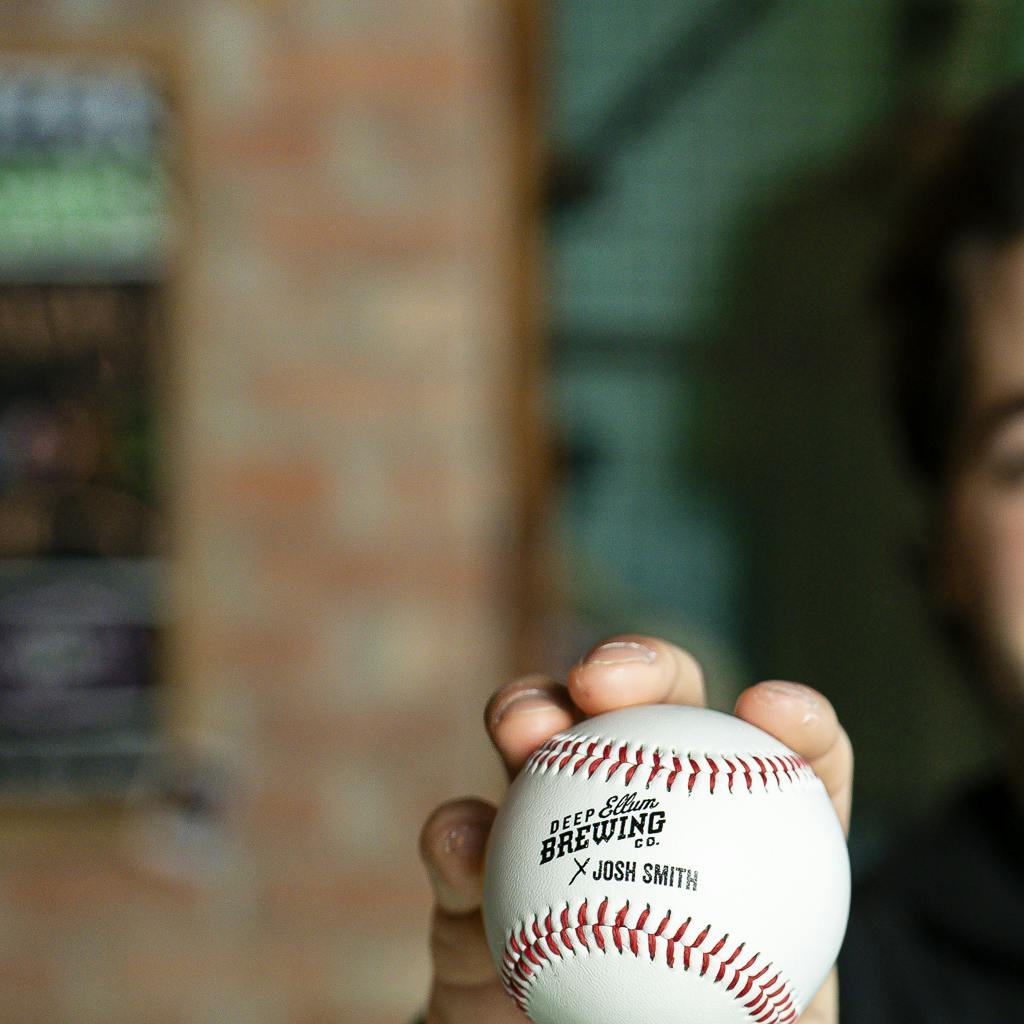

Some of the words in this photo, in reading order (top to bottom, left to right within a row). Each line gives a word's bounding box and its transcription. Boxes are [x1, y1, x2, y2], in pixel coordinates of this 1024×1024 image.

[550, 808, 595, 835] DEEP
[598, 791, 659, 818] Ellum
[539, 810, 667, 865] BREWING
[634, 836, 660, 848] CO.
[592, 860, 637, 882] JOSH
[642, 862, 699, 891] SMITH
